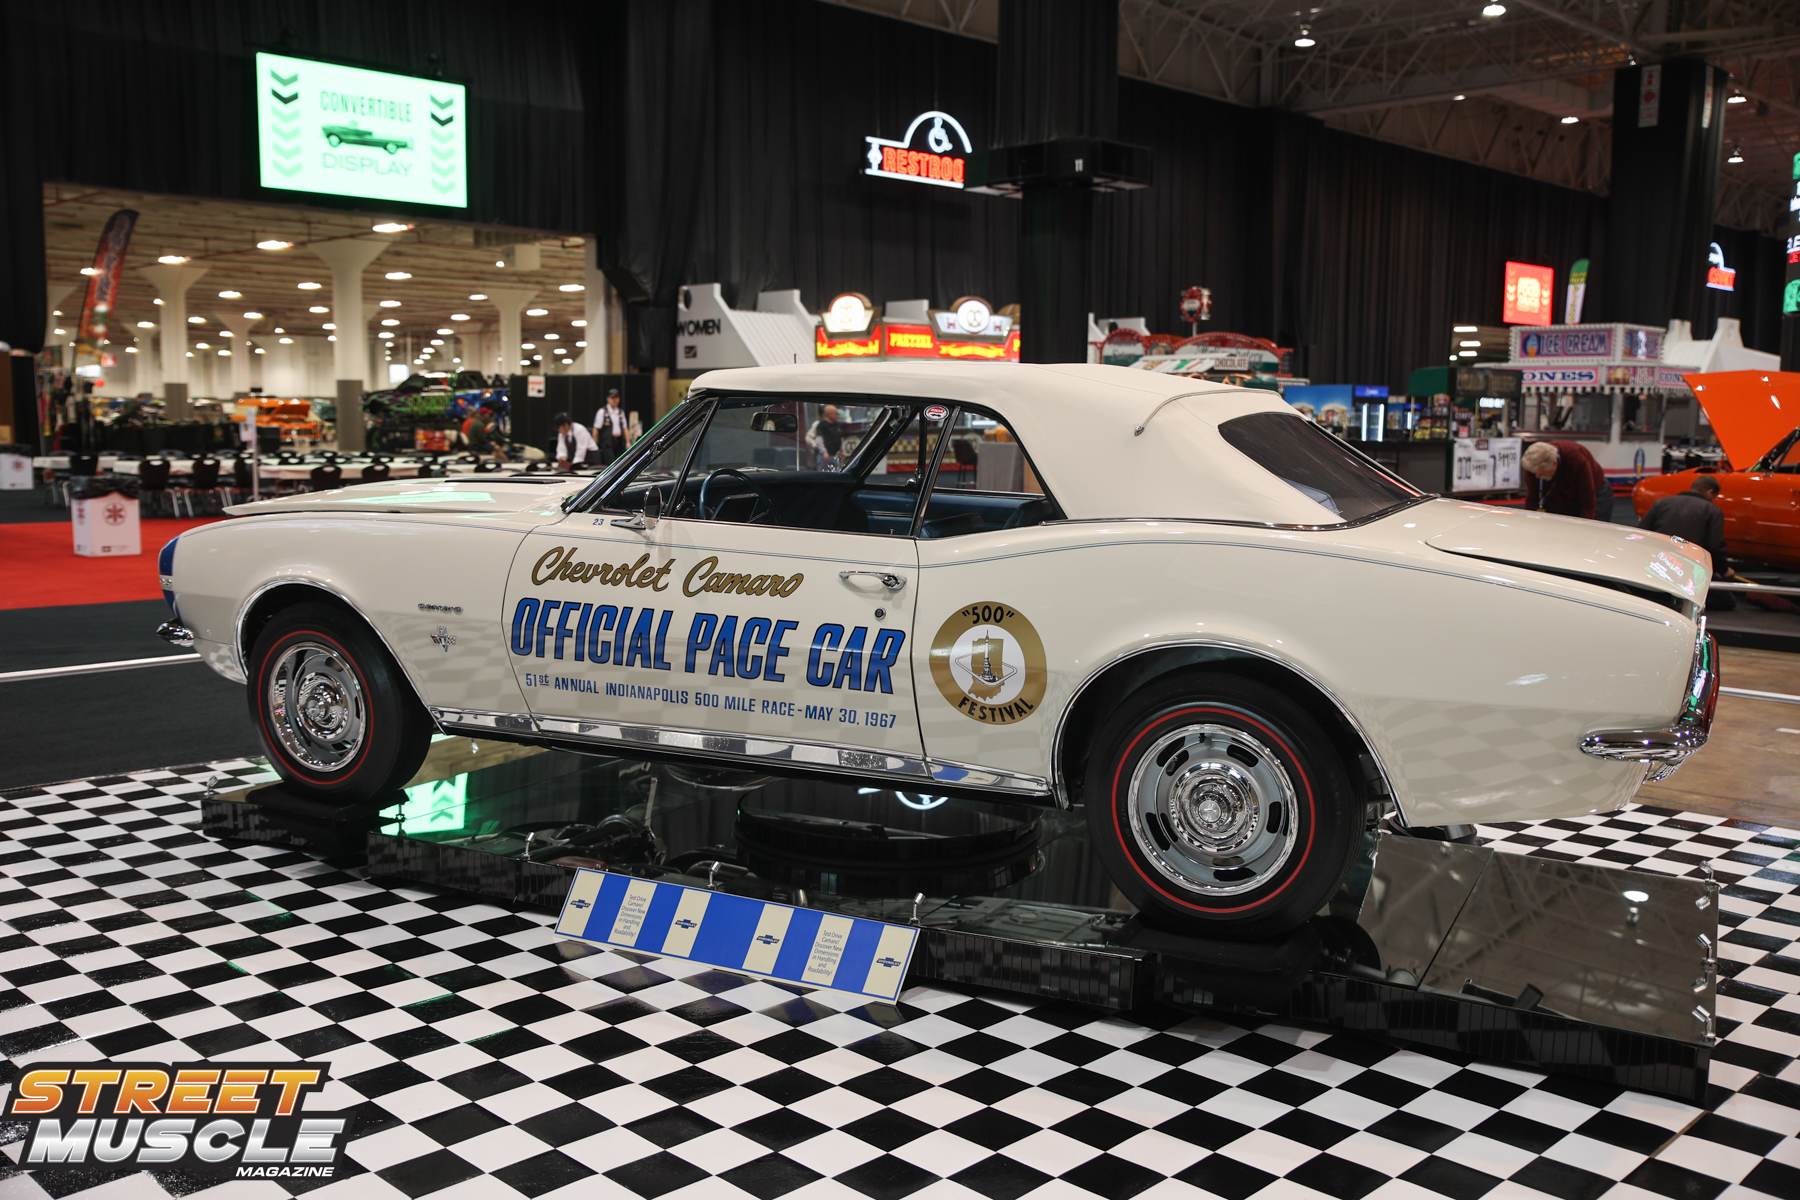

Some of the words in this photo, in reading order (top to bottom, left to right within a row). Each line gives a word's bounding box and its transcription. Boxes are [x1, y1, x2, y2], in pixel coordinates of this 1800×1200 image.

[320, 90, 412, 123] CONVERTIBLE
[321, 152, 413, 177] DISPLAY
[677, 317, 721, 337] WOMEN
[889, 332, 934, 349] PRETZEL
[1540, 331, 1562, 355] ICE
[1563, 331, 1609, 355] CREAM
[1214, 356, 1247, 369] CHOCOLATE
[592, 518, 605, 526] 23
[531, 545, 676, 592] Chevrolet
[682, 555, 805, 598] Camaro
[511, 597, 674, 671] OFFICIAL
[685, 612, 799, 683] PACE
[806, 623, 906, 694] CAR
[554, 677, 600, 694] ANNUAL
[605, 682, 689, 705] INDIANAPOLIS
[695, 692, 719, 708] 500
[724, 696, 756, 713] MILE
[865, 711, 897, 729] 1967
[957, 696, 1034, 722] FESTIVAL
[621, 912, 642, 920] Dimensions
[623, 918, 640, 926] Handling
[814, 948, 838, 957] Dimensions
[817, 956, 836, 965] Handling
